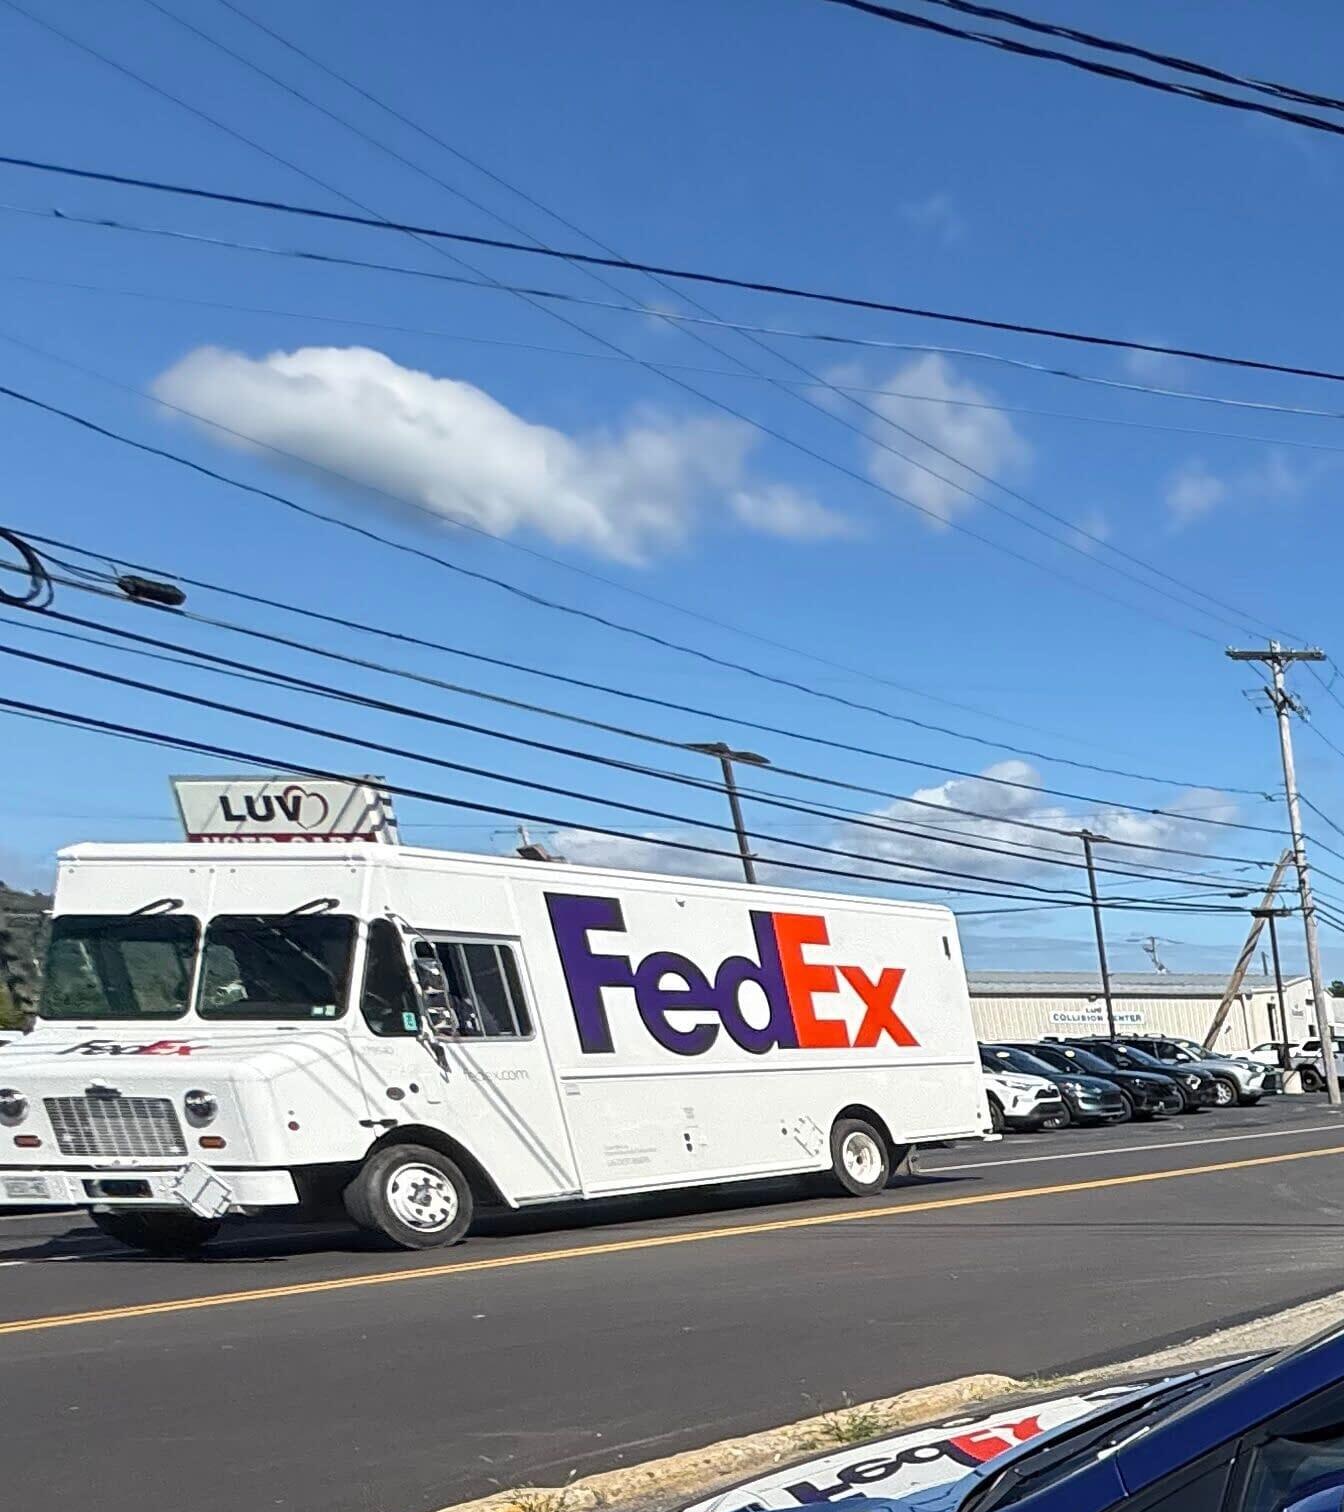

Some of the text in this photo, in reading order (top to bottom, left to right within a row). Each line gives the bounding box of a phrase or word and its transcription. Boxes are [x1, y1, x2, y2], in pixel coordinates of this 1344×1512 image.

[219, 795, 301, 822] LUV
[543, 891, 921, 1056] FedEx
[1053, 1013, 1142, 1022] COLLISION ENTER
